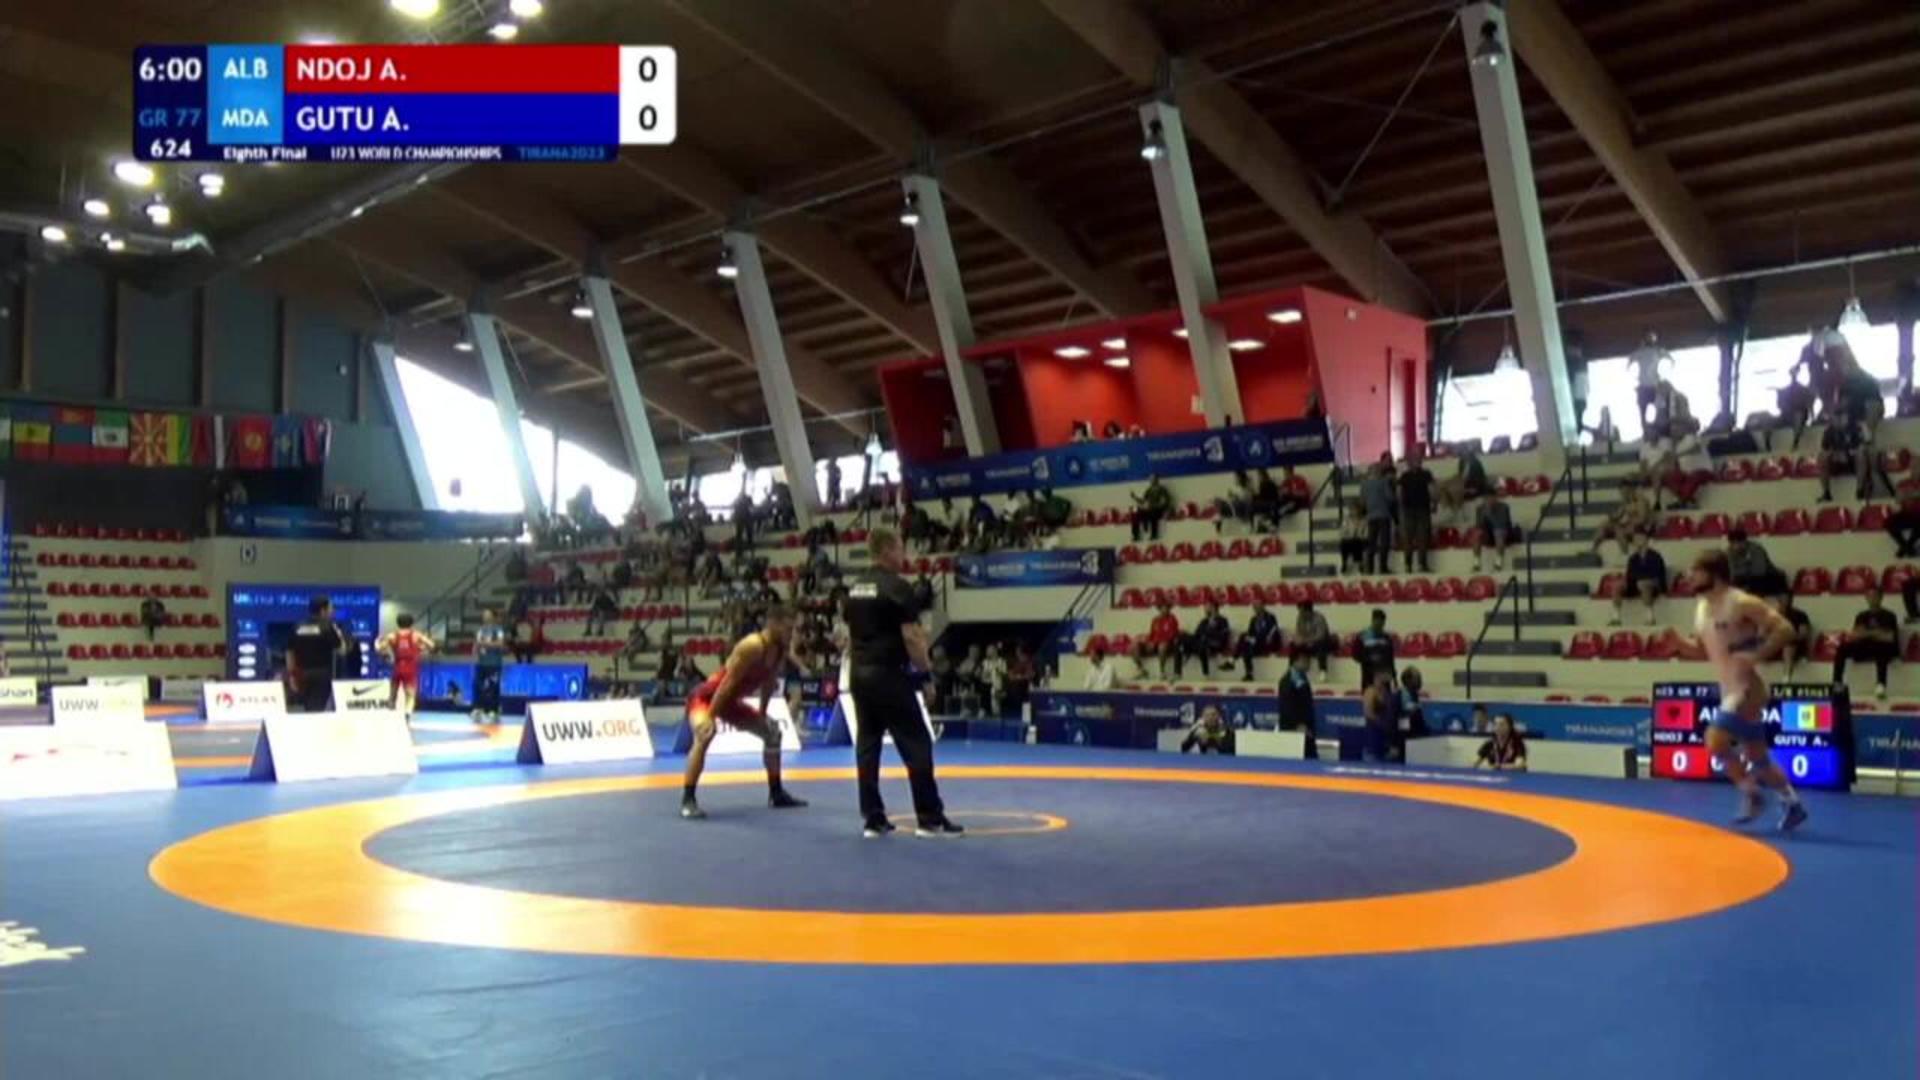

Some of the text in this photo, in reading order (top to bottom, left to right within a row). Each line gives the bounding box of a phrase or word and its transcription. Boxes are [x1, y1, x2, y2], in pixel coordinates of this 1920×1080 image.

[542, 720, 641, 742] UWW.ORG
[1774, 734, 1808, 746] GUTU
[1672, 750, 1688, 772] 0
[1792, 754, 1809, 778] 0
